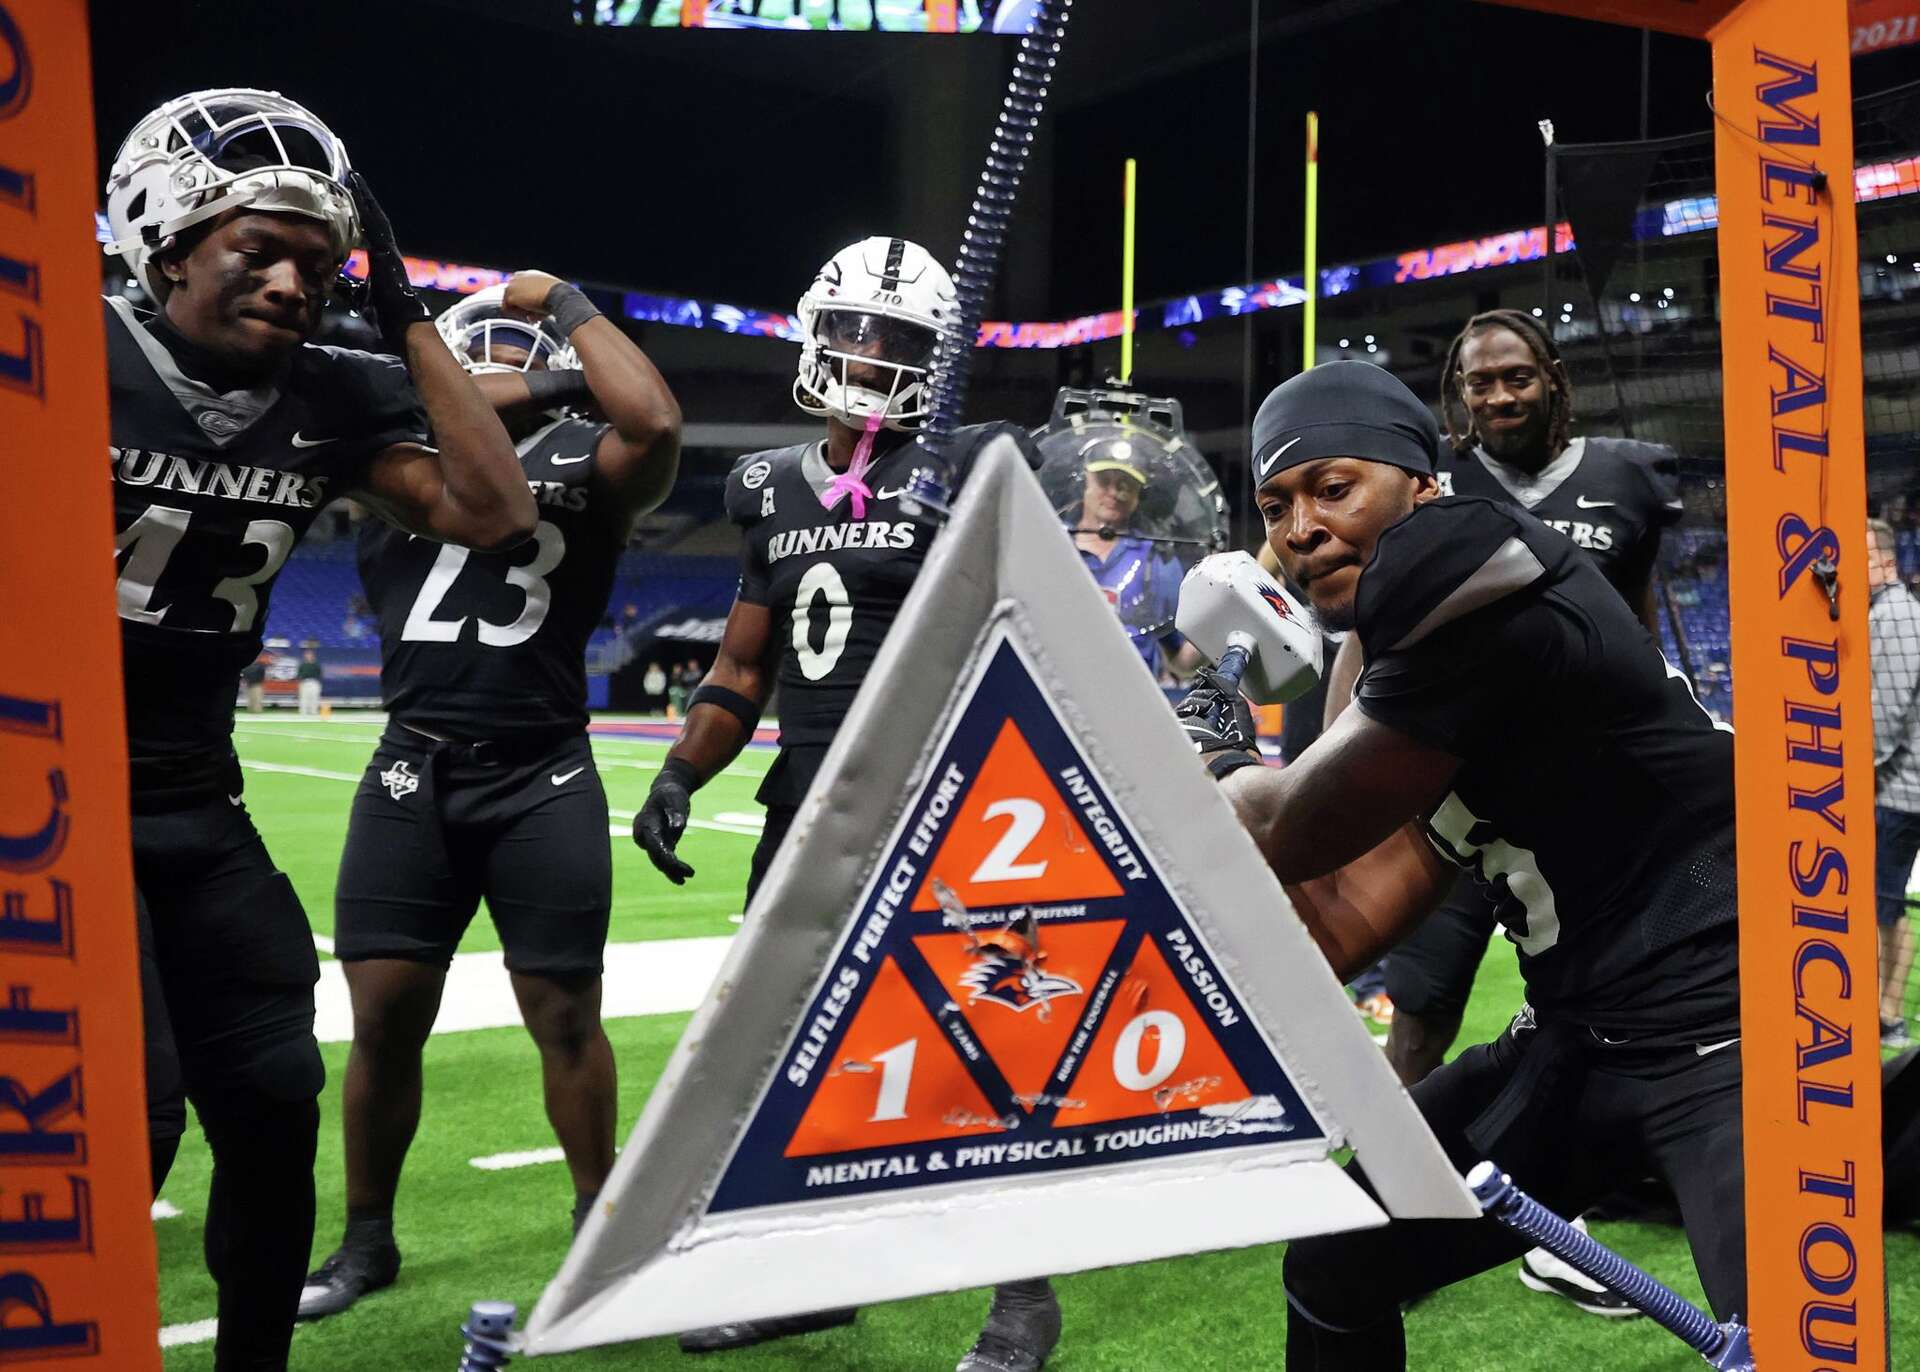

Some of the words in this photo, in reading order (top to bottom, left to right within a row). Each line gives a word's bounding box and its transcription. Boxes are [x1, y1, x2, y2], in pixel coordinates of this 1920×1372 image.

[1752, 43, 1830, 475] MENTAL
[768, 521, 916, 564] RUNNERS
[1777, 511, 1840, 600] &
[791, 561, 854, 681] 0
[969, 797, 1050, 884] 2
[1060, 765, 1148, 882] INTEGRITY
[787, 965, 861, 1088] SELFLESS
[852, 855, 917, 964] PERFECT
[907, 761, 965, 857] EFFORT
[942, 908, 1006, 928] PSICAL
[1031, 903, 1088, 920] DEFENSE
[1779, 635, 1855, 1126] PHYSICAL
[1165, 927, 1240, 1028] PASSION
[865, 1037, 918, 1123] 1
[948, 1020, 980, 1062] TEAMS
[1070, 1030, 1089, 1055] THE
[1112, 1010, 1186, 1092] 0
[805, 1154, 920, 1187] MENTAL
[926, 1151, 950, 1172] &
[955, 1138, 1086, 1169] PHYSICAL
[1094, 1118, 1242, 1153] TOUGHNESS
[1797, 1158, 1857, 1372] TOU
